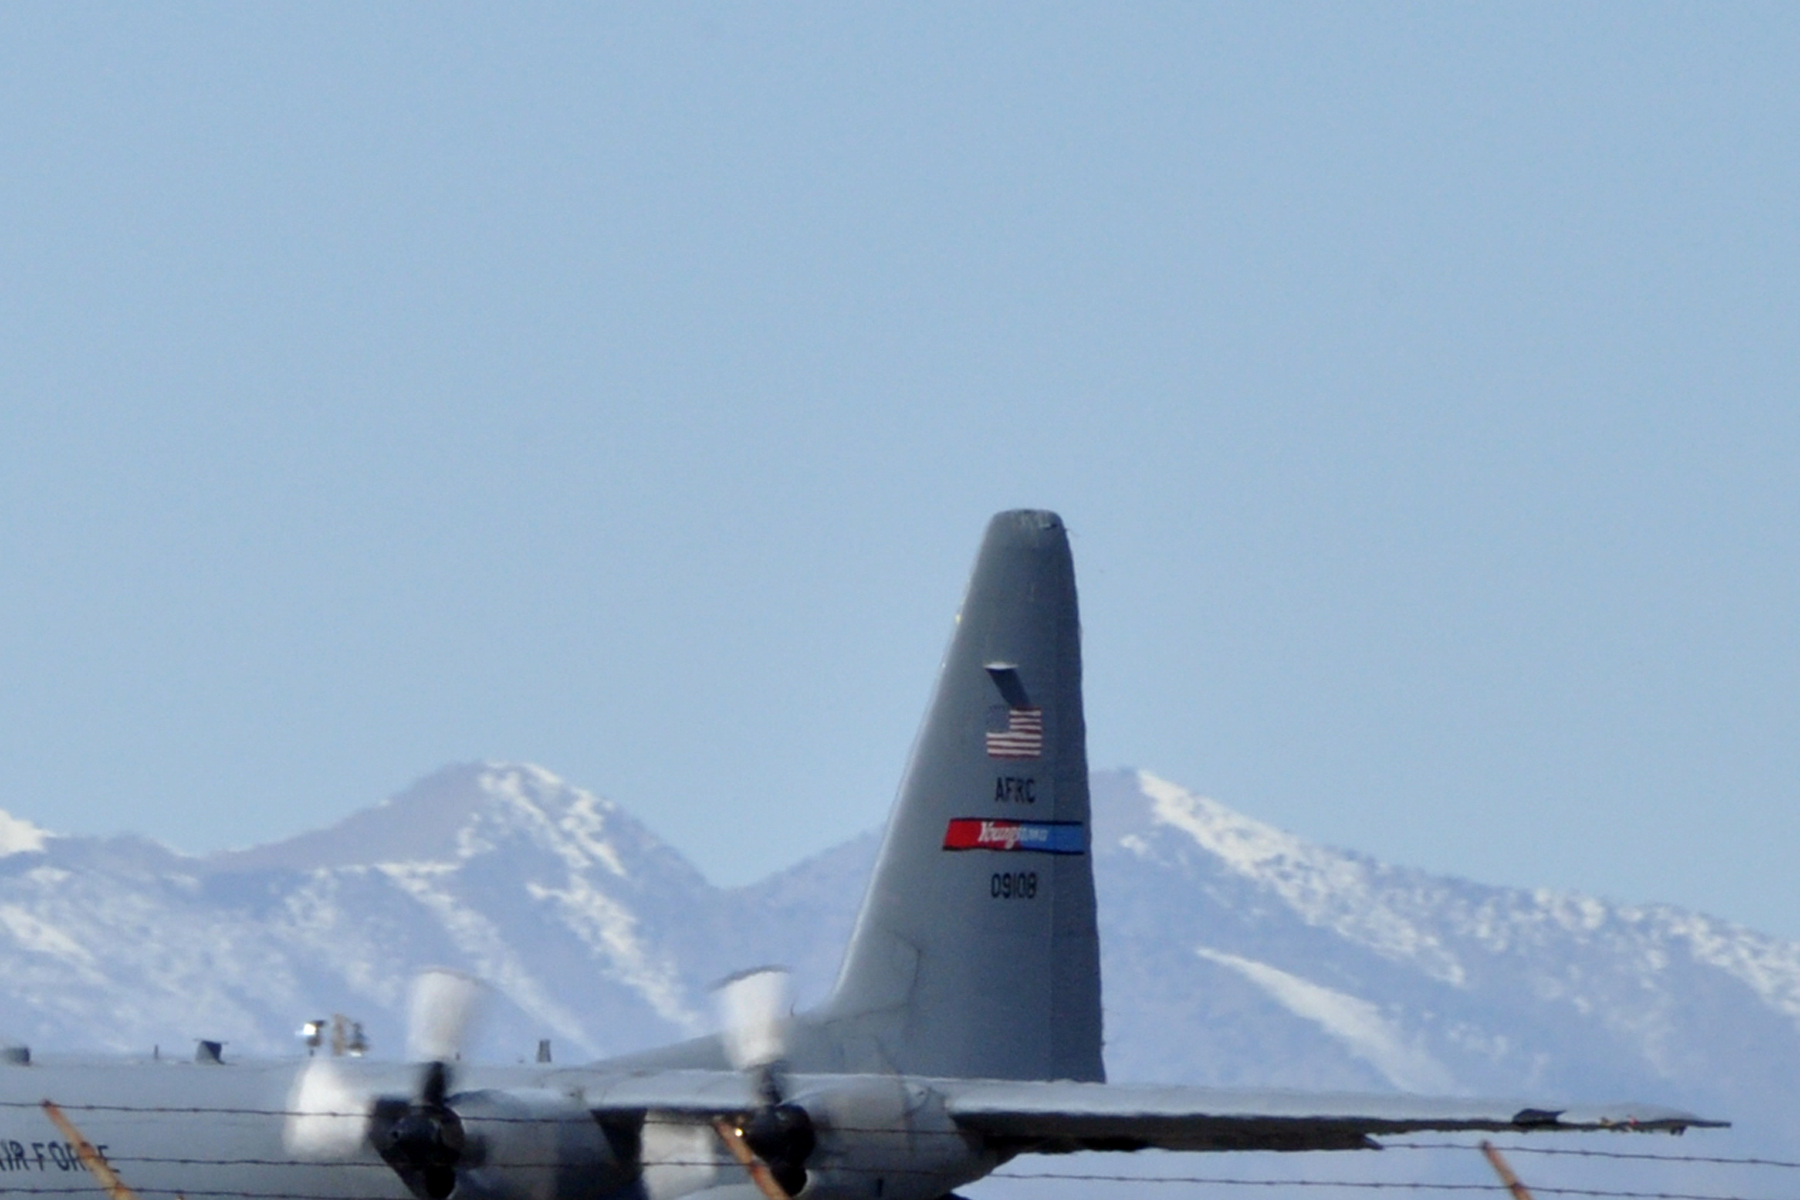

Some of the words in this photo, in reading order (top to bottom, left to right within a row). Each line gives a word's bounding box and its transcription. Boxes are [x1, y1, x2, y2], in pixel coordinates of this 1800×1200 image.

[995, 777, 1036, 803] AFRC
[991, 872, 1037, 899] 09108
[31, 1141, 121, 1174] FORE
